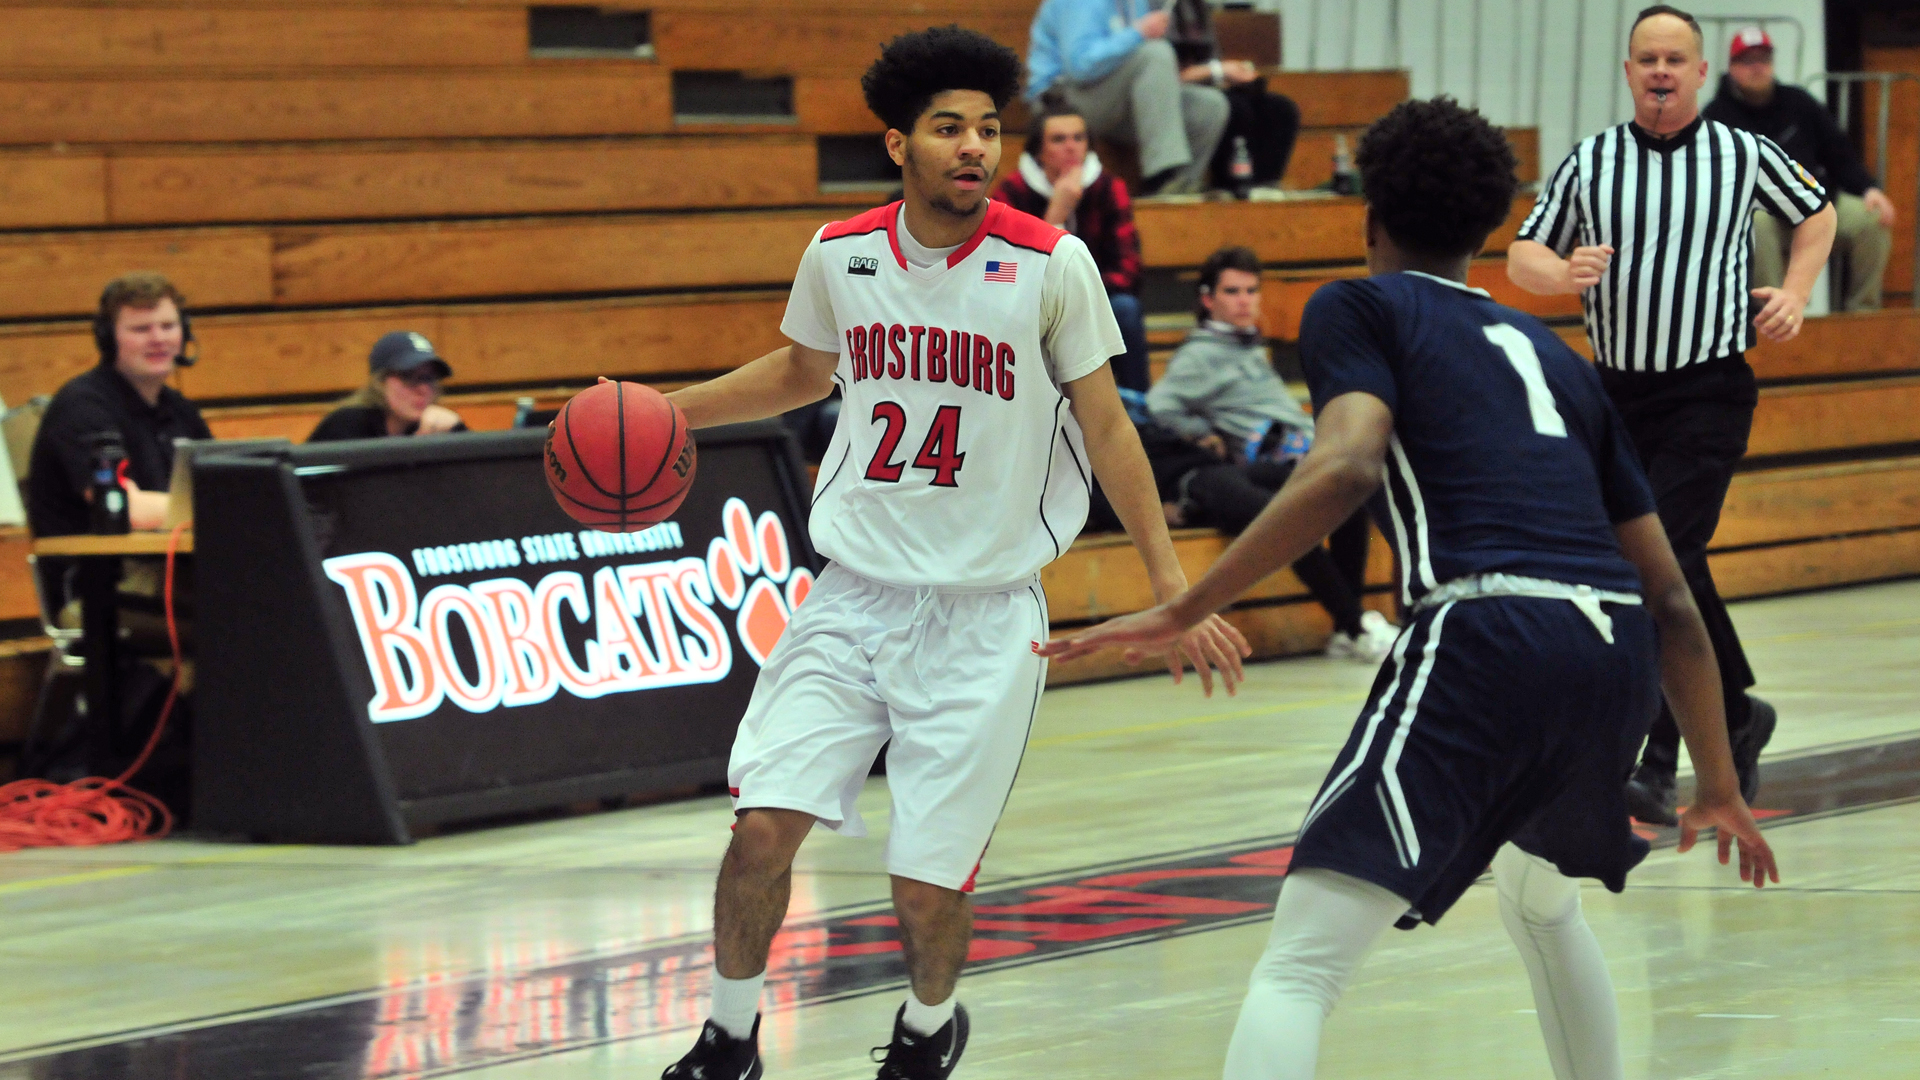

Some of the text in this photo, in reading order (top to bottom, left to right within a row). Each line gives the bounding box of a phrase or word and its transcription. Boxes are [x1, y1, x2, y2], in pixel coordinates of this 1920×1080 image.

[849, 256, 879, 271] CAC
[1482, 323, 1568, 438] 1
[864, 401, 966, 488] 24
[411, 538, 522, 577] FROSTBURG
[520, 532, 580, 565] STATE
[323, 552, 732, 723] BOBCATS
